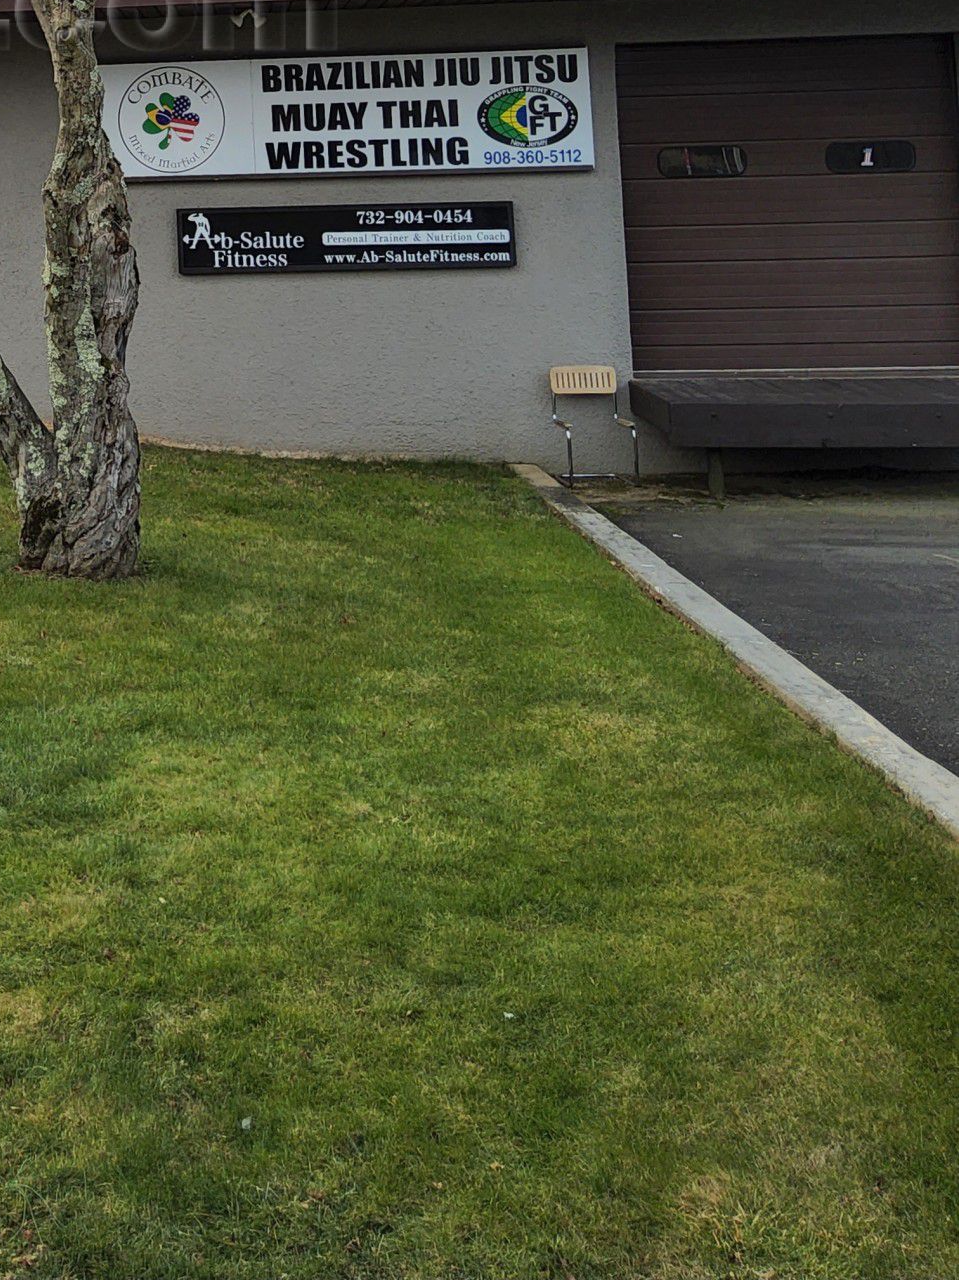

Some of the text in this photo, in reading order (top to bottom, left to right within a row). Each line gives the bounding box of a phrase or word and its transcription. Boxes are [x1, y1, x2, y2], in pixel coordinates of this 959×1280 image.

[261, 54, 578, 92] BRAZILIAN JIU JITSU
[127, 71, 215, 104] COMBATE
[485, 86, 570, 105] GRAPPLING FIGHT TEAM
[271, 99, 459, 132] MUAY THAI
[129, 131, 216, 169] Mixed Martial Arts
[510, 138, 526, 148] New
[265, 137, 470, 170] WRESTLING
[483, 149, 581, 165] 908-360-5112
[356, 209, 473, 225] 732-904-0454
[326, 231, 506, 244] Personal Trainer & Nutrition Coach
[213, 249, 288, 268] Fitness
[324, 249, 511, 264] www.Ab-SaluteFitness.com
